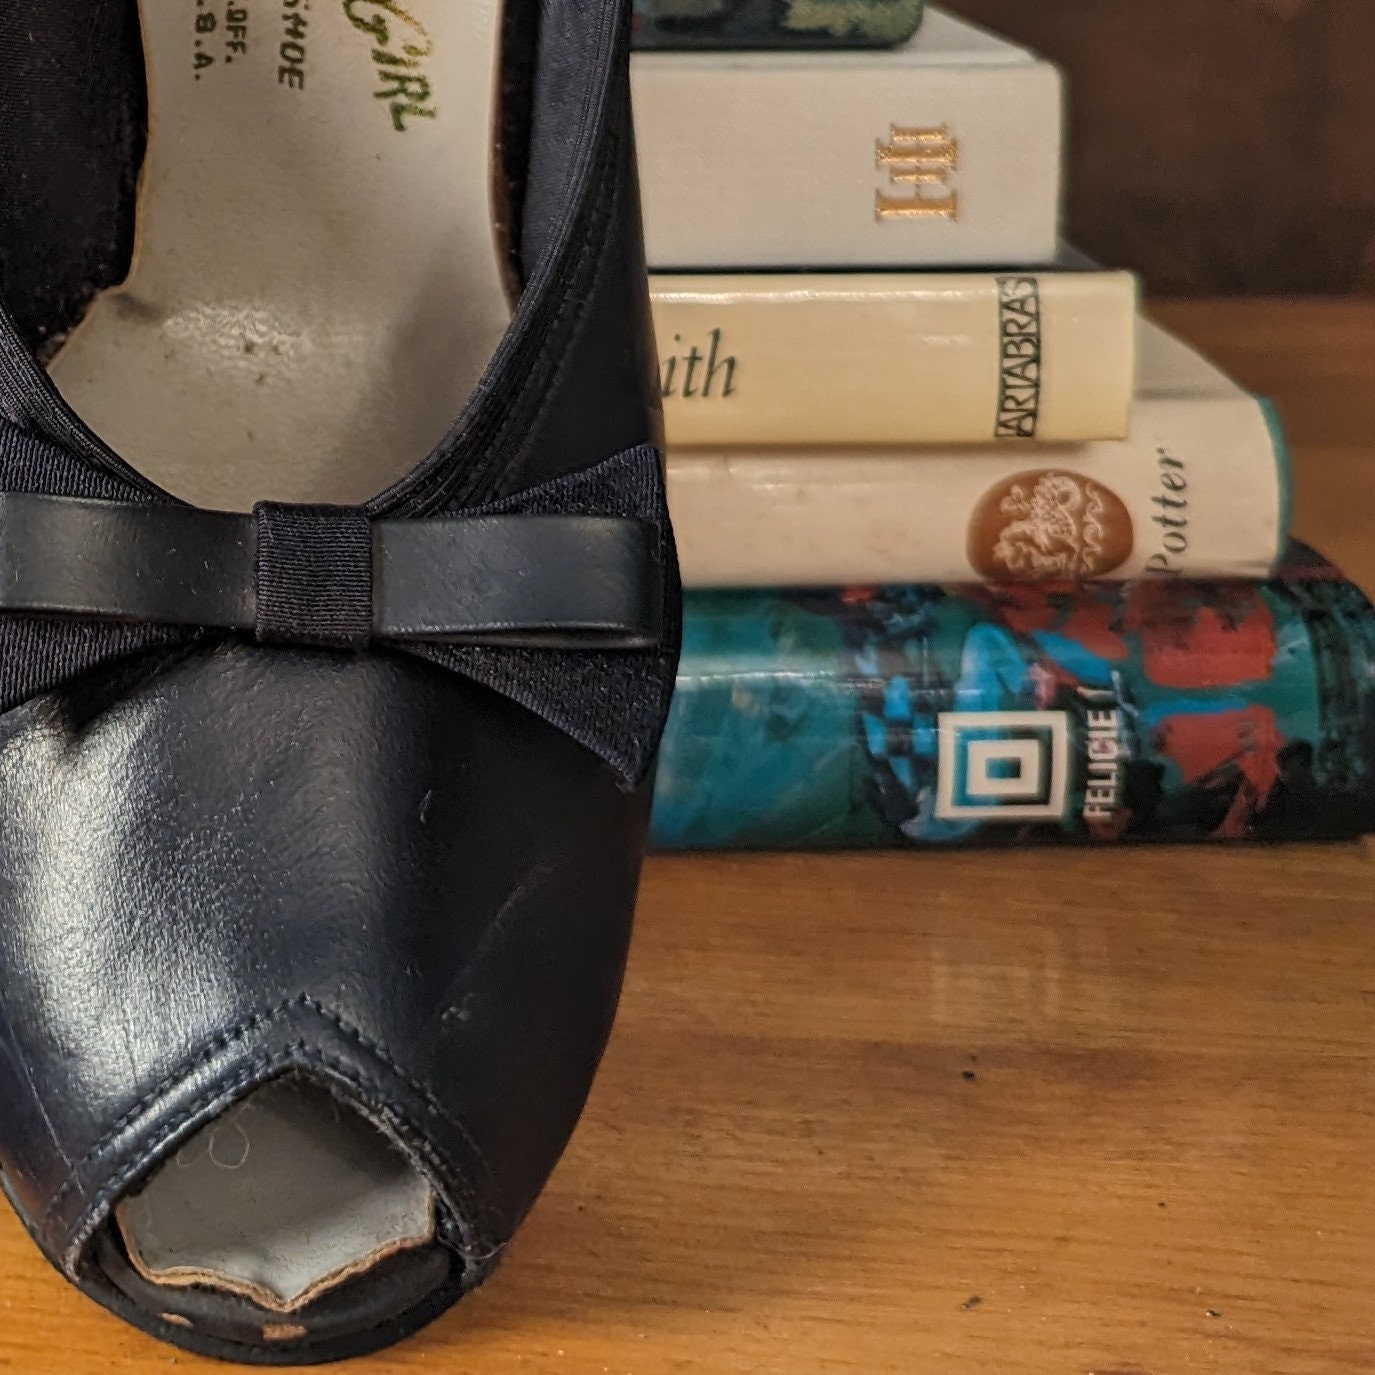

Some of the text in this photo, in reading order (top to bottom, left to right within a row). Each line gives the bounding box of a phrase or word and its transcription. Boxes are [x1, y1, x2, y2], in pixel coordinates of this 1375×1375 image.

[660, 327, 736, 398] ith
[996, 277, 1041, 437] ARTABRAS
[1144, 447, 1188, 574] Potter
[1083, 709, 1118, 819] FELICIE
